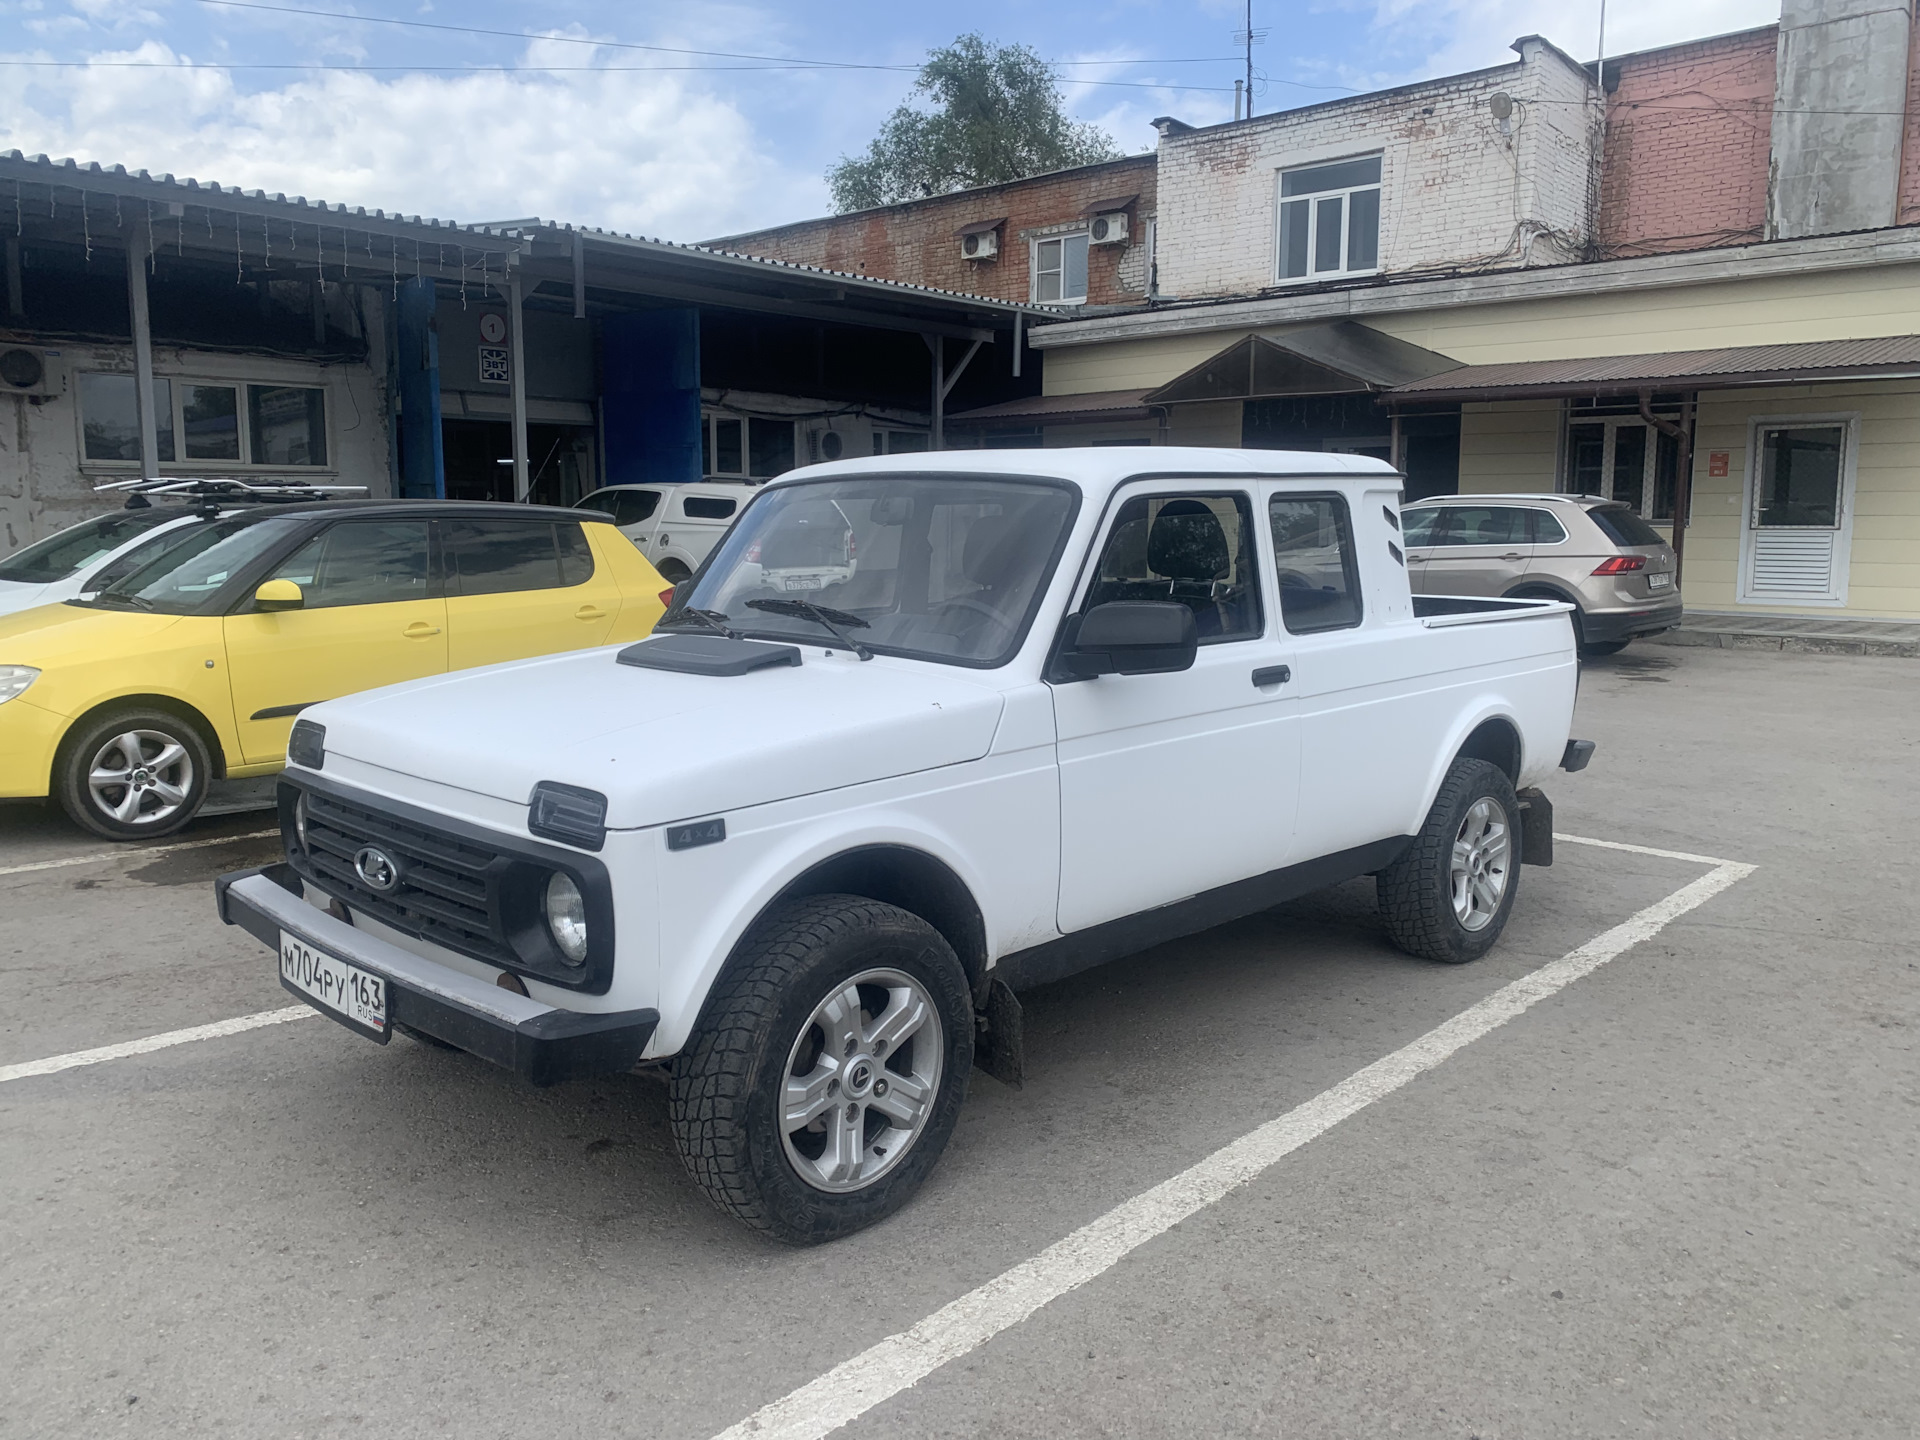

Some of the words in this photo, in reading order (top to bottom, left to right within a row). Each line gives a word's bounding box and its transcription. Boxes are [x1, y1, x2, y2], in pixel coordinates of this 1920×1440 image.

[489, 323, 496, 334] 1
[284, 943, 345, 1004] М704РУ
[350, 972, 381, 1011] 163
[357, 1004, 373, 1021] RUS
